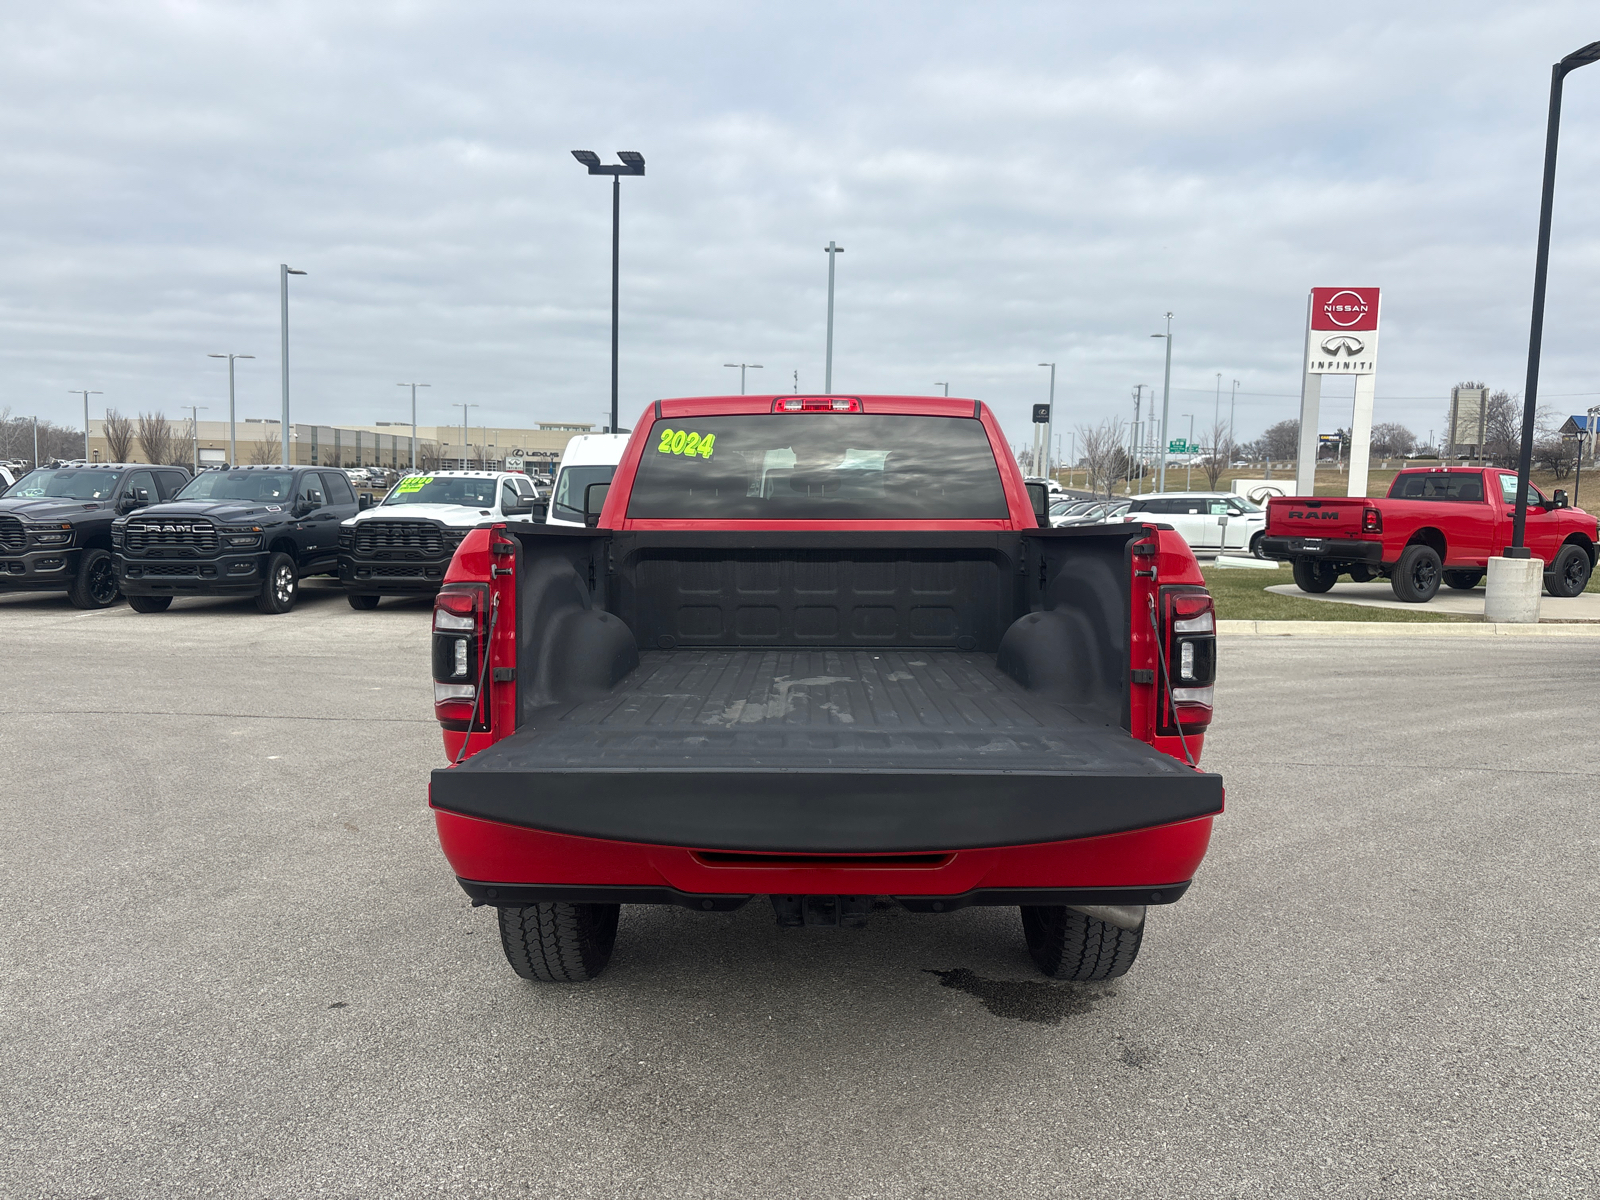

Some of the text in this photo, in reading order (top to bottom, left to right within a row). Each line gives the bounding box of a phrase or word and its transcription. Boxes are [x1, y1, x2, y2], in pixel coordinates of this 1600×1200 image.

[1311, 361, 1372, 370] INFINITI
[658, 428, 716, 459] 2024
[1288, 511, 1340, 520] RAM
[146, 525, 192, 533] RAM
